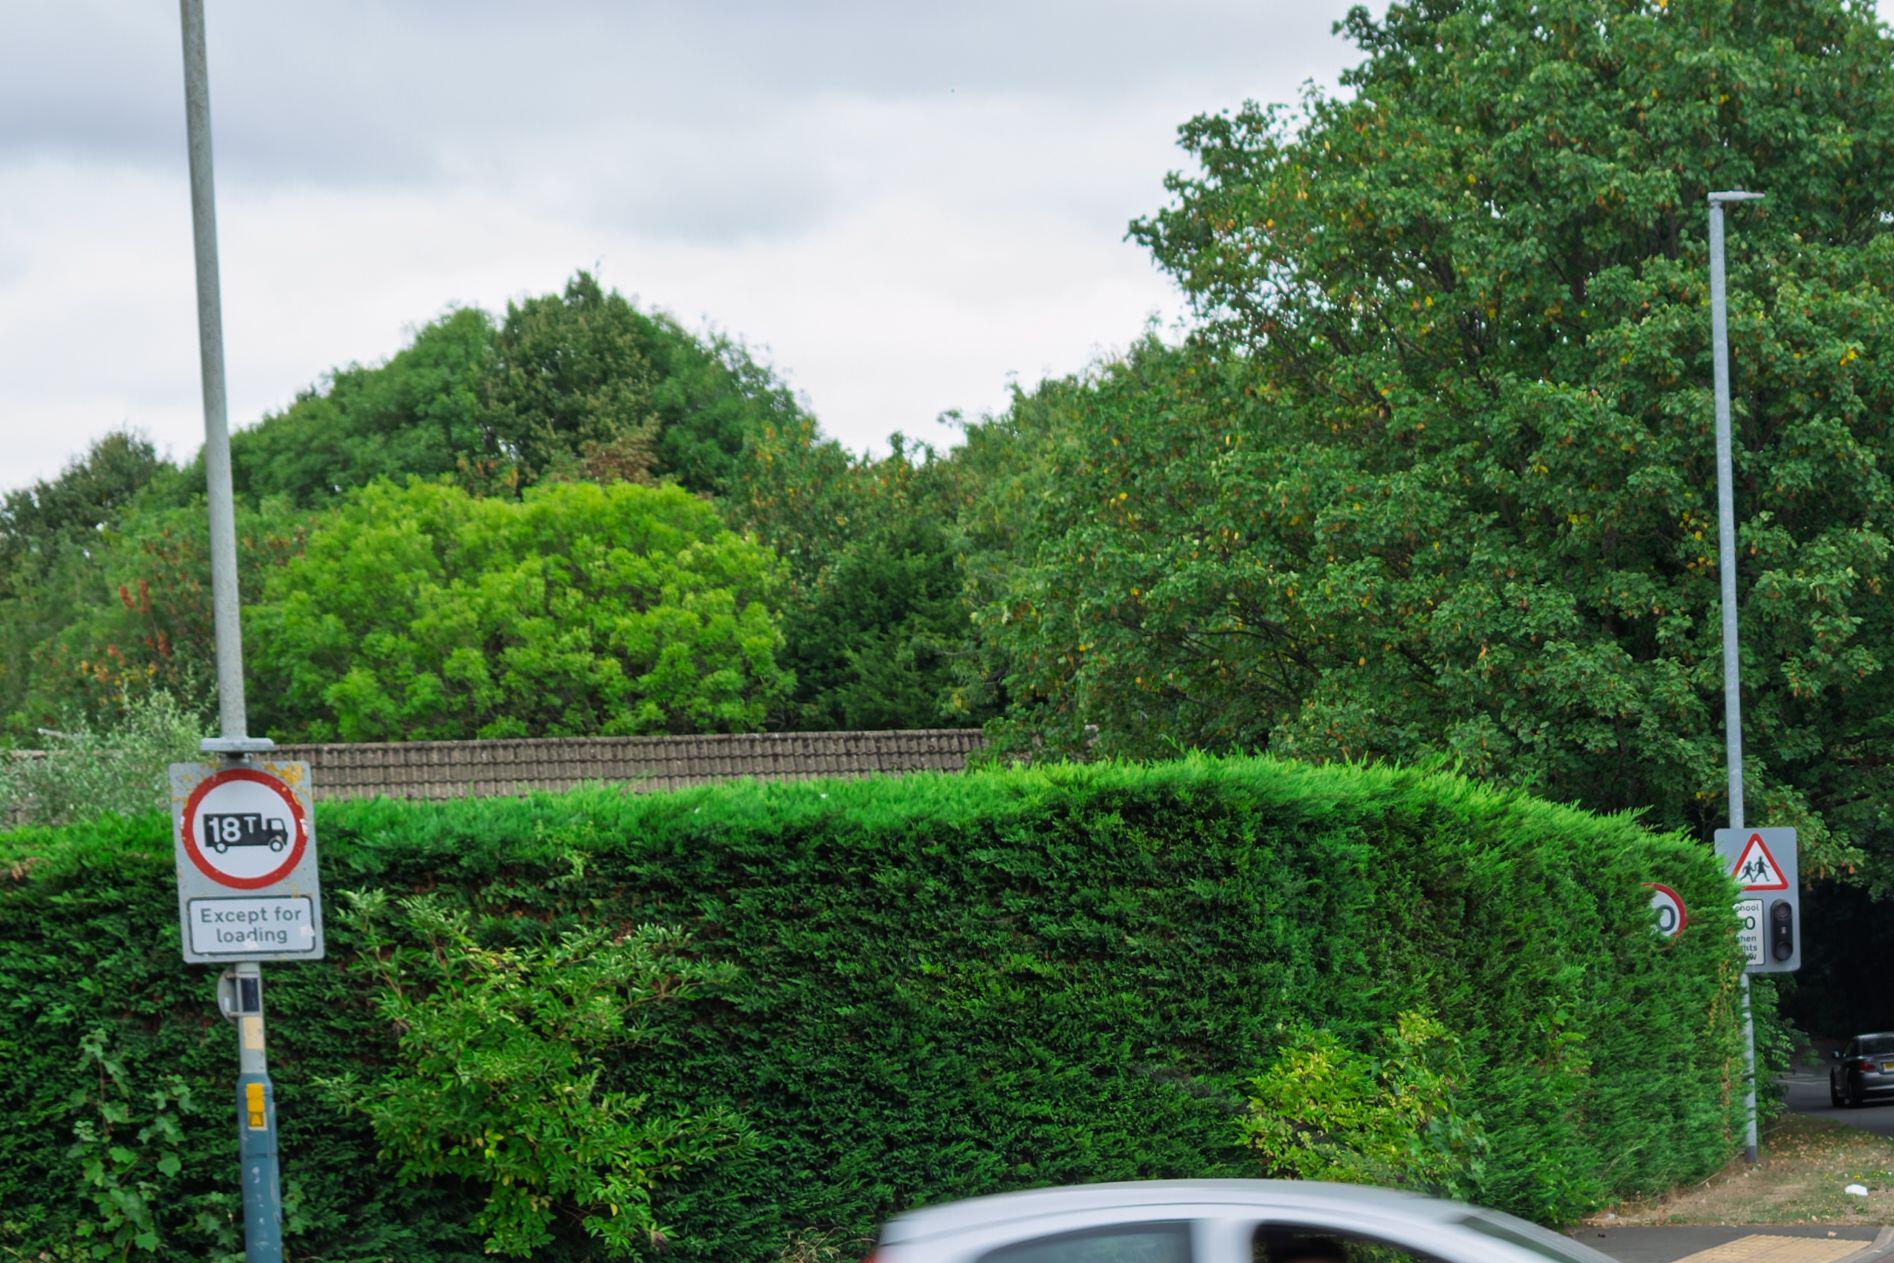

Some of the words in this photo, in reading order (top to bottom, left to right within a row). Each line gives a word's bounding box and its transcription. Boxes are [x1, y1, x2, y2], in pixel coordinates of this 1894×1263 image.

[201, 907, 268, 925] Except
[275, 906, 301, 921] for
[1736, 903, 1760, 912] chool
[1656, 904, 1676, 932] 0
[1745, 915, 1756, 930] 0
[217, 927, 288, 944] loading
